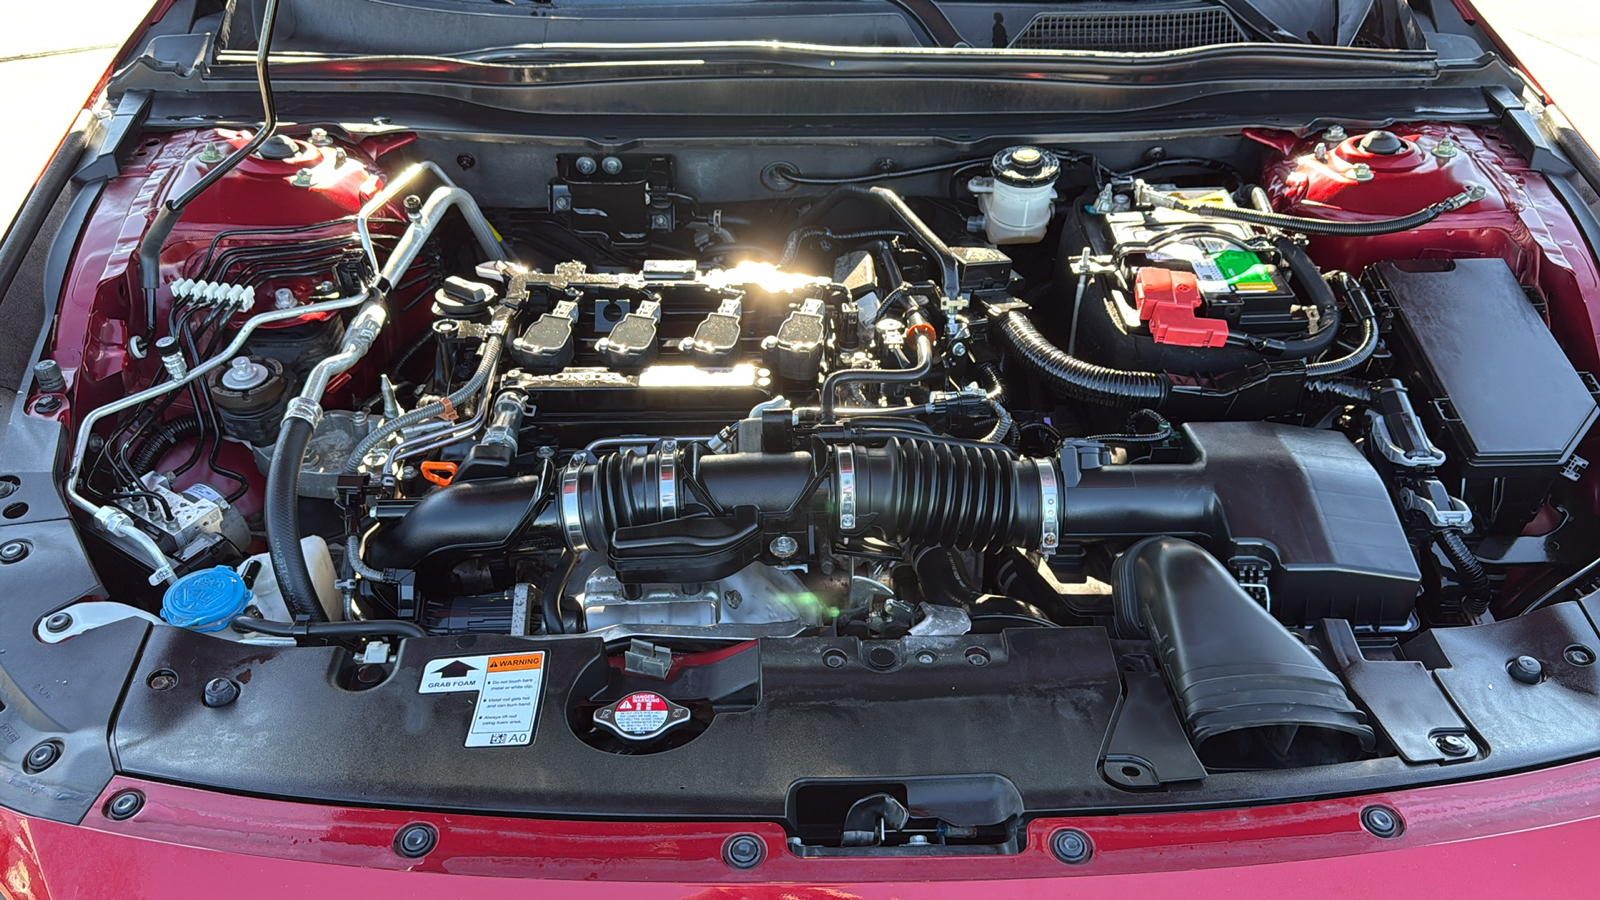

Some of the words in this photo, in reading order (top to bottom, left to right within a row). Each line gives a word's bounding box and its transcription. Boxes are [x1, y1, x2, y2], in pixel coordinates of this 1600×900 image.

[531, 372, 627, 383] HONDA
[499, 657, 540, 667] WARNING
[508, 733, 527, 743] A0
